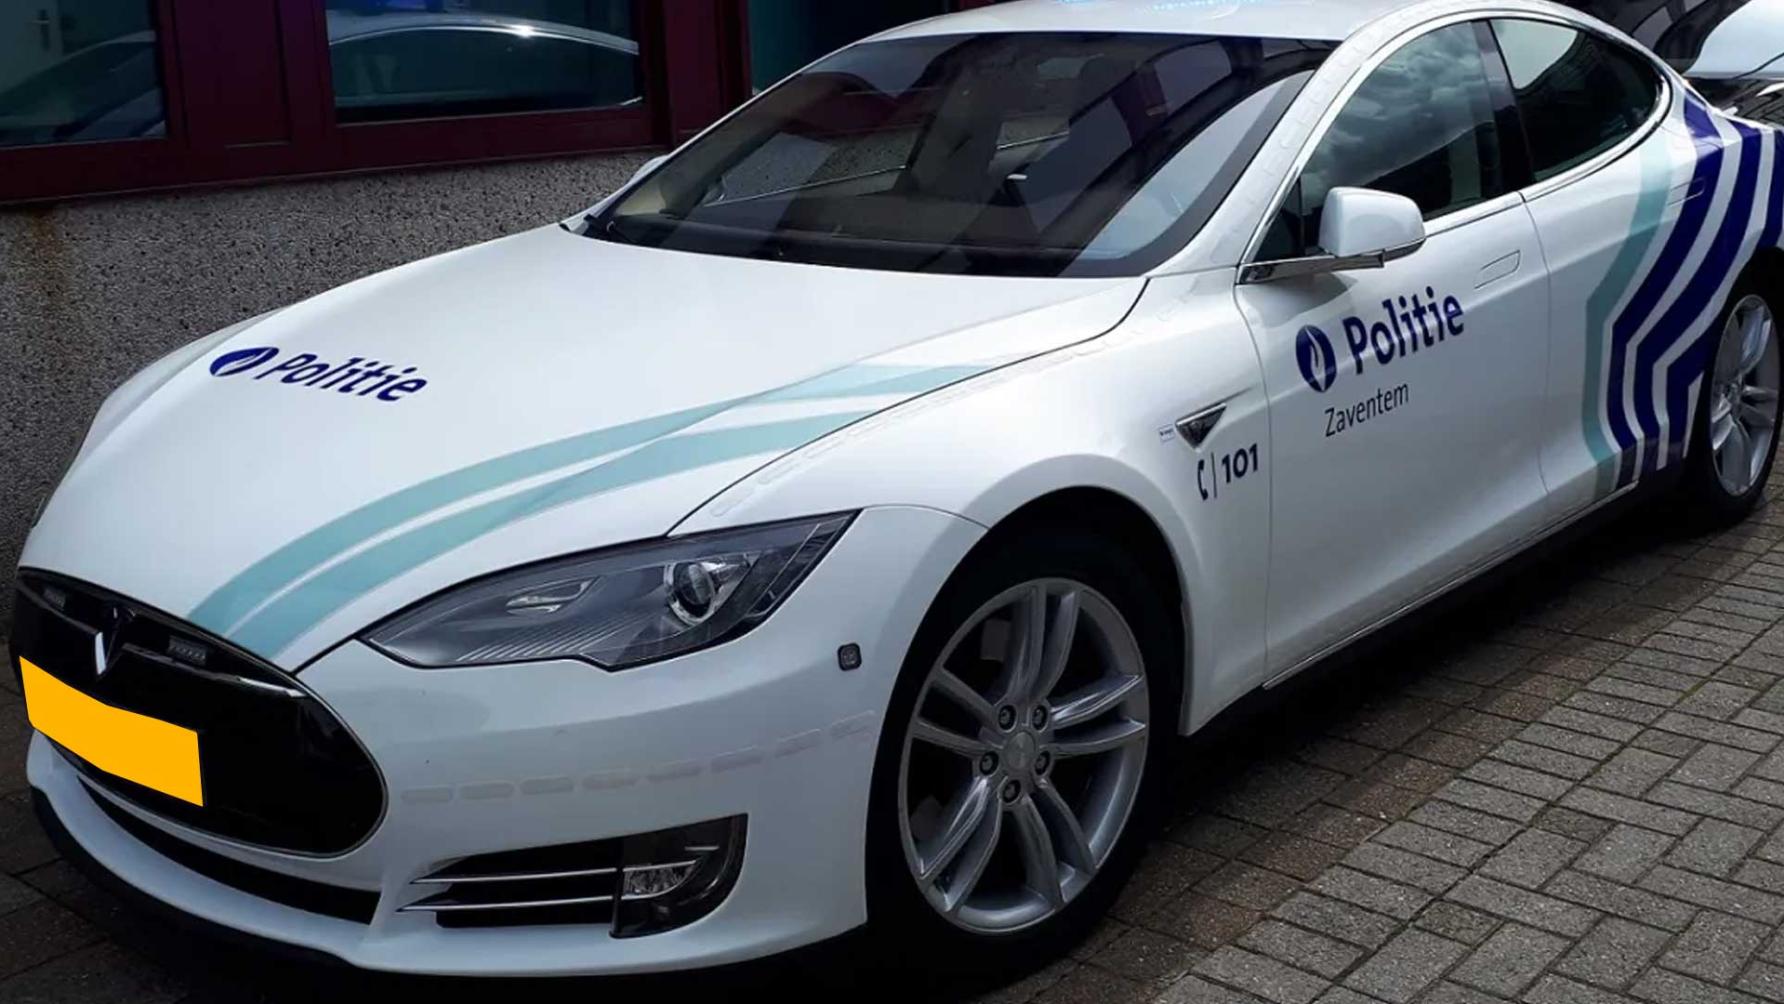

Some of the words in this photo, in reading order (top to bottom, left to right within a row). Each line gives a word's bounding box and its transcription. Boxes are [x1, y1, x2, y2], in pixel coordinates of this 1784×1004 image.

[1342, 286, 1465, 375] Politie
[253, 353, 428, 402] Politie
[1324, 383, 1410, 438] Zaventem
[1221, 442, 1259, 484] 101
